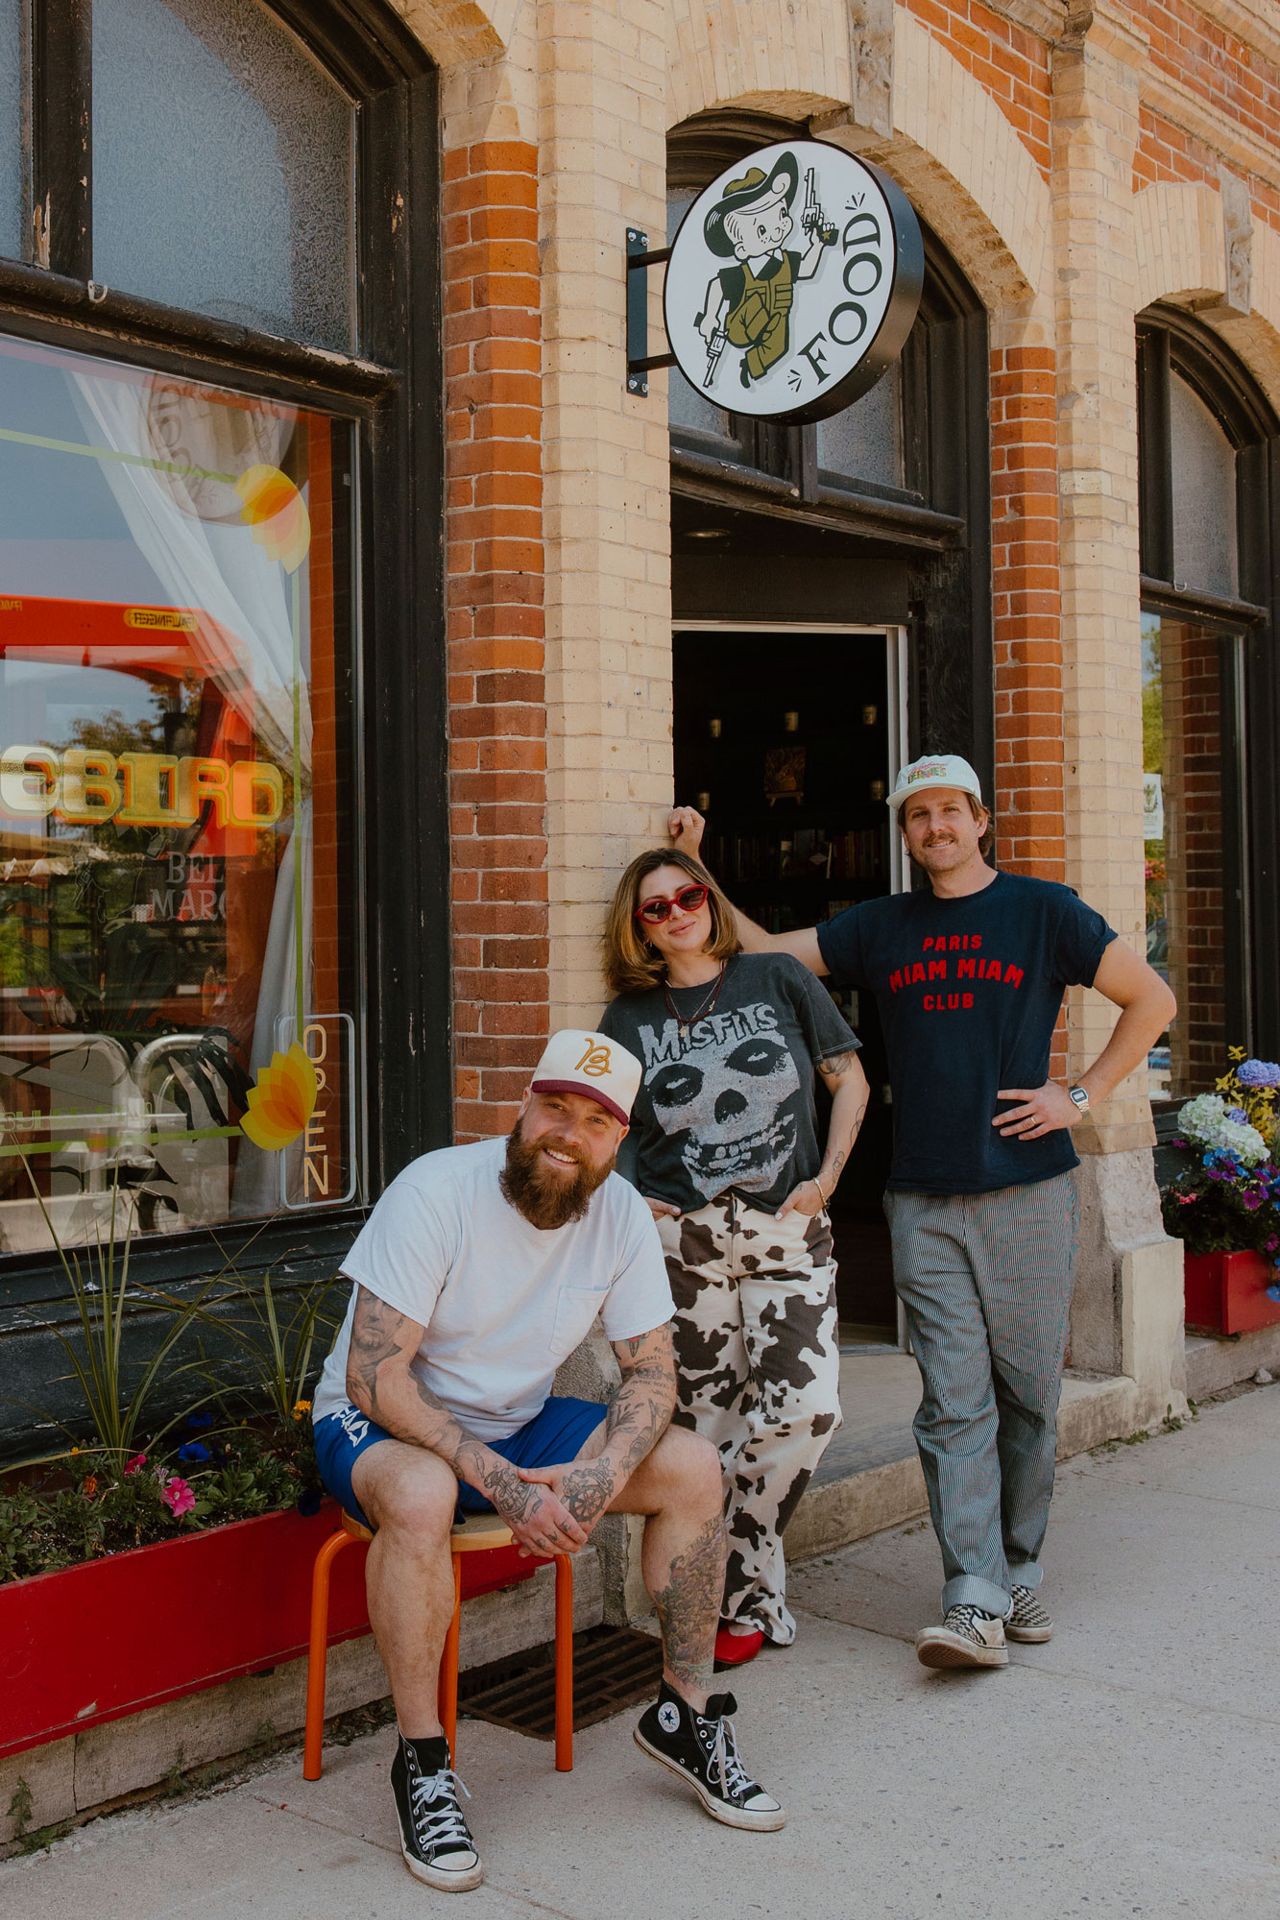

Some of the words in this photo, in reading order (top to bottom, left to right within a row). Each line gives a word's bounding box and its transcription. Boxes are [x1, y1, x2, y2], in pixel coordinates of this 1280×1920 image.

[797, 213, 882, 385] FOOD
[922, 934, 983, 952] PARIS
[888, 959, 947, 993] MIAM
[957, 958, 1025, 989] MIAM
[923, 992, 974, 1011] CLUB
